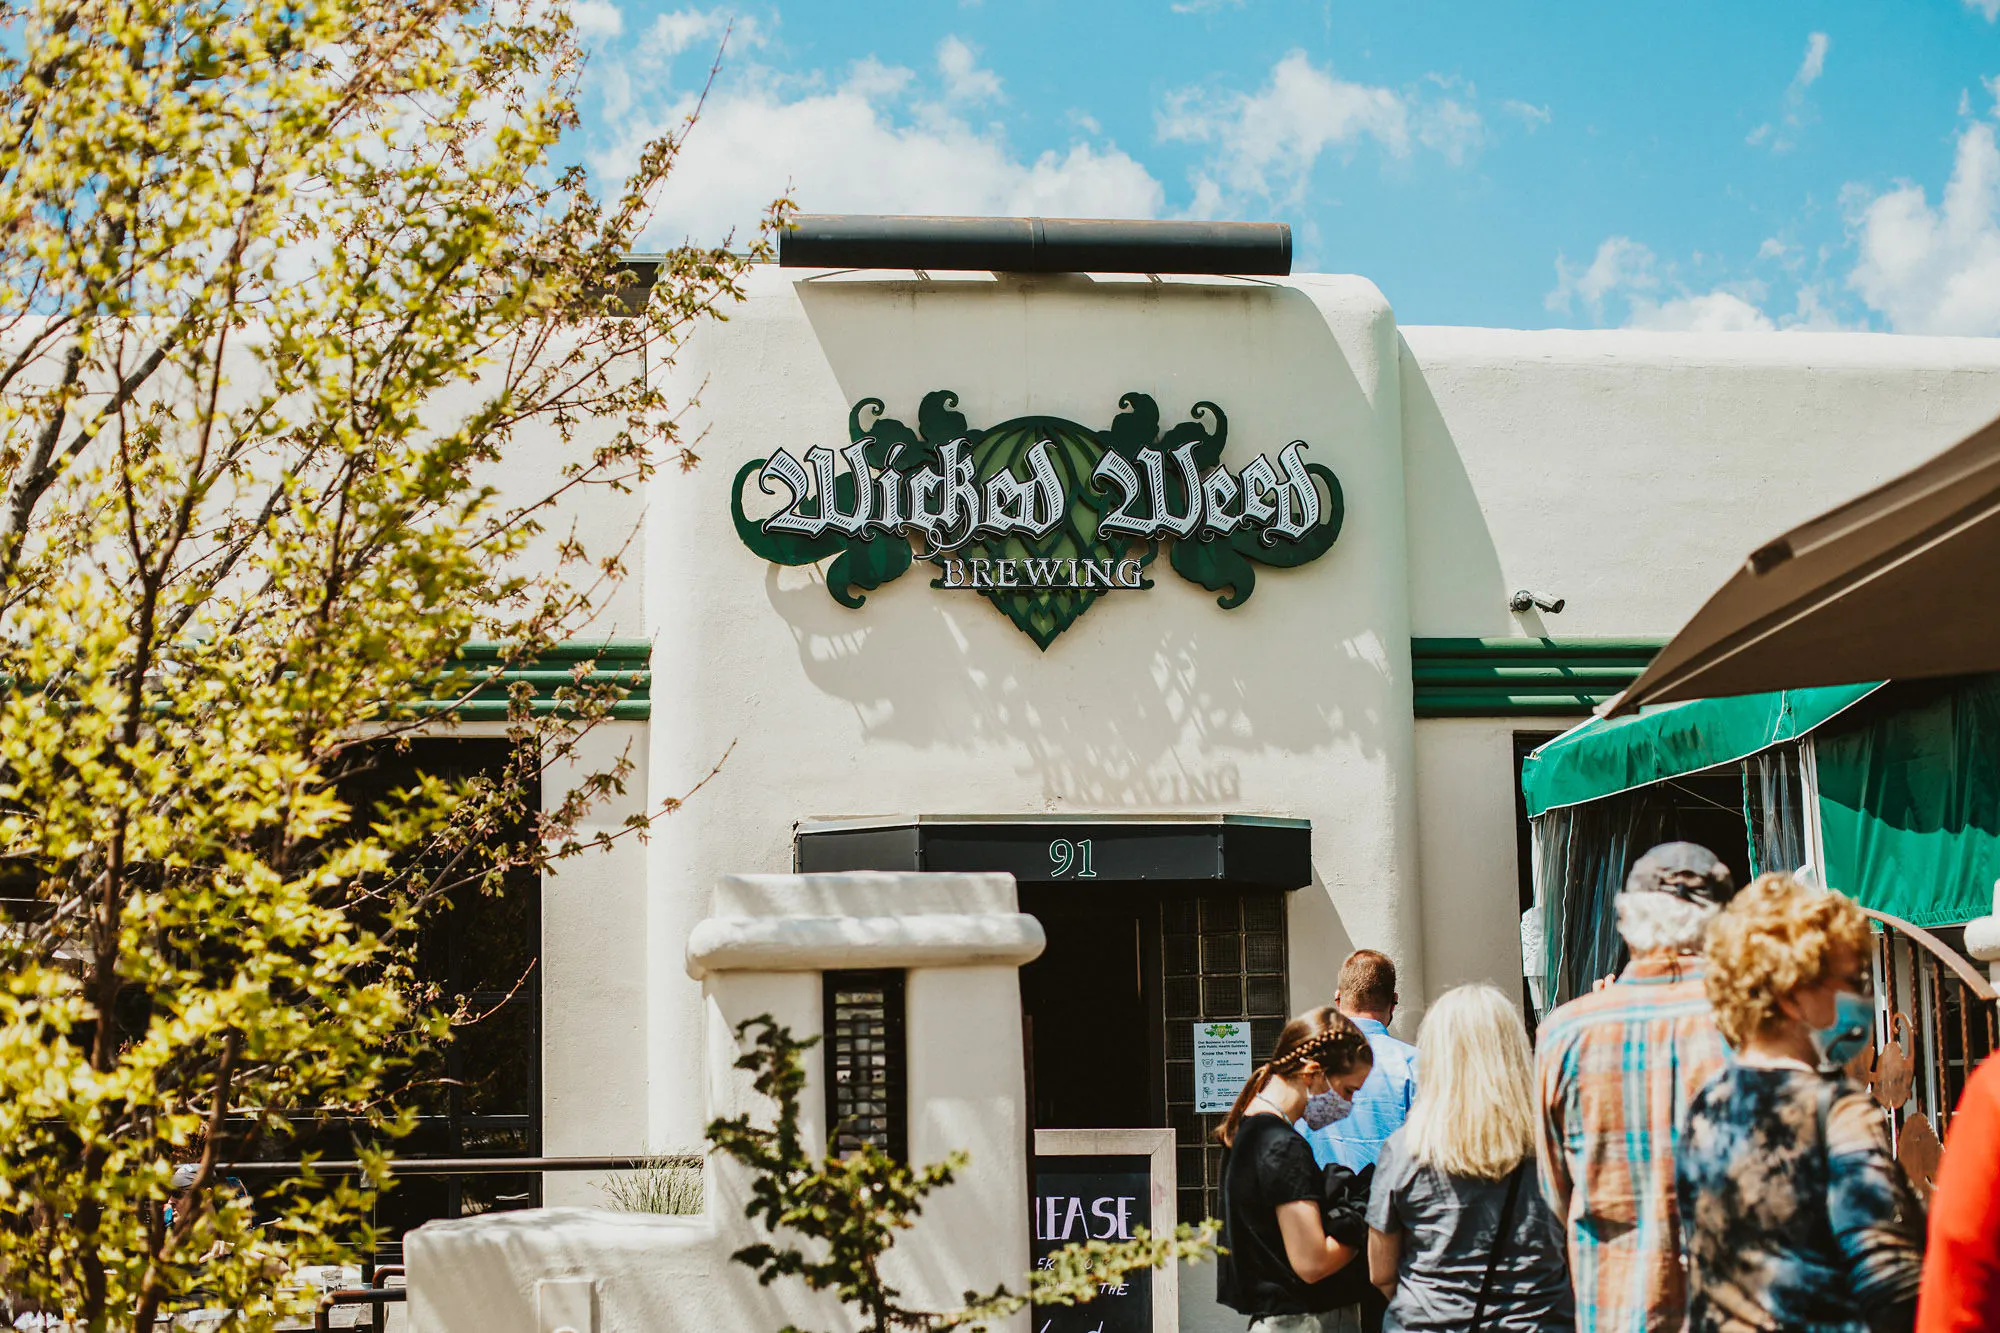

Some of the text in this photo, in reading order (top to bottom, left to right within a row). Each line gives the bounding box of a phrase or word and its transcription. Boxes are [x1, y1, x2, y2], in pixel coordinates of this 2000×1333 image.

[760, 436, 1321, 560] Wicked Weed
[943, 557, 1143, 588] BREWING
[1049, 838, 1097, 877] 91
[1035, 1196, 1137, 1240] LEASE
[1099, 1283, 1130, 1296] THE
